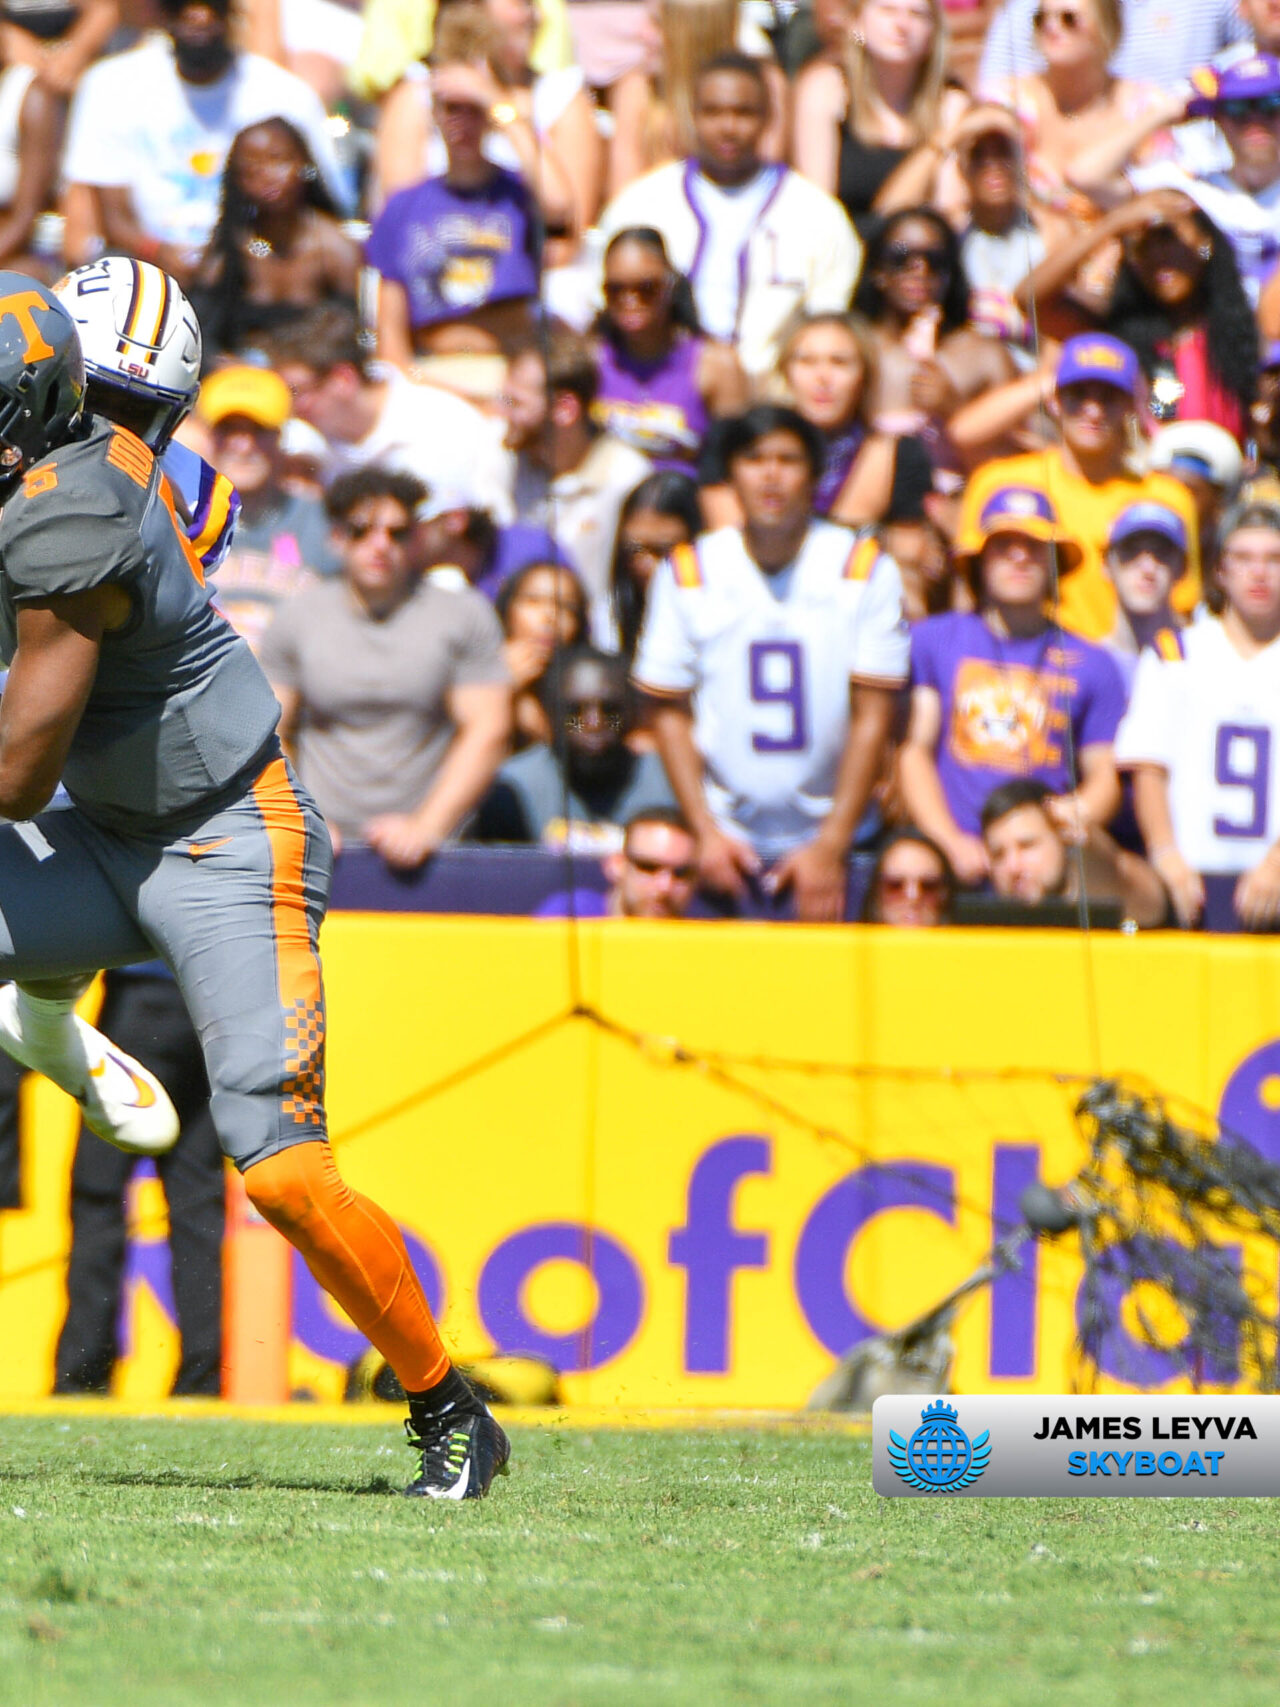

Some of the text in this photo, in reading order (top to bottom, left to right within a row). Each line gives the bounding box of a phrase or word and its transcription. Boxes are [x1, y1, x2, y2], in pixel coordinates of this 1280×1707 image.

[118, 359, 149, 379] LSU
[749, 641, 804, 752] 9
[1214, 724, 1271, 838] 9
